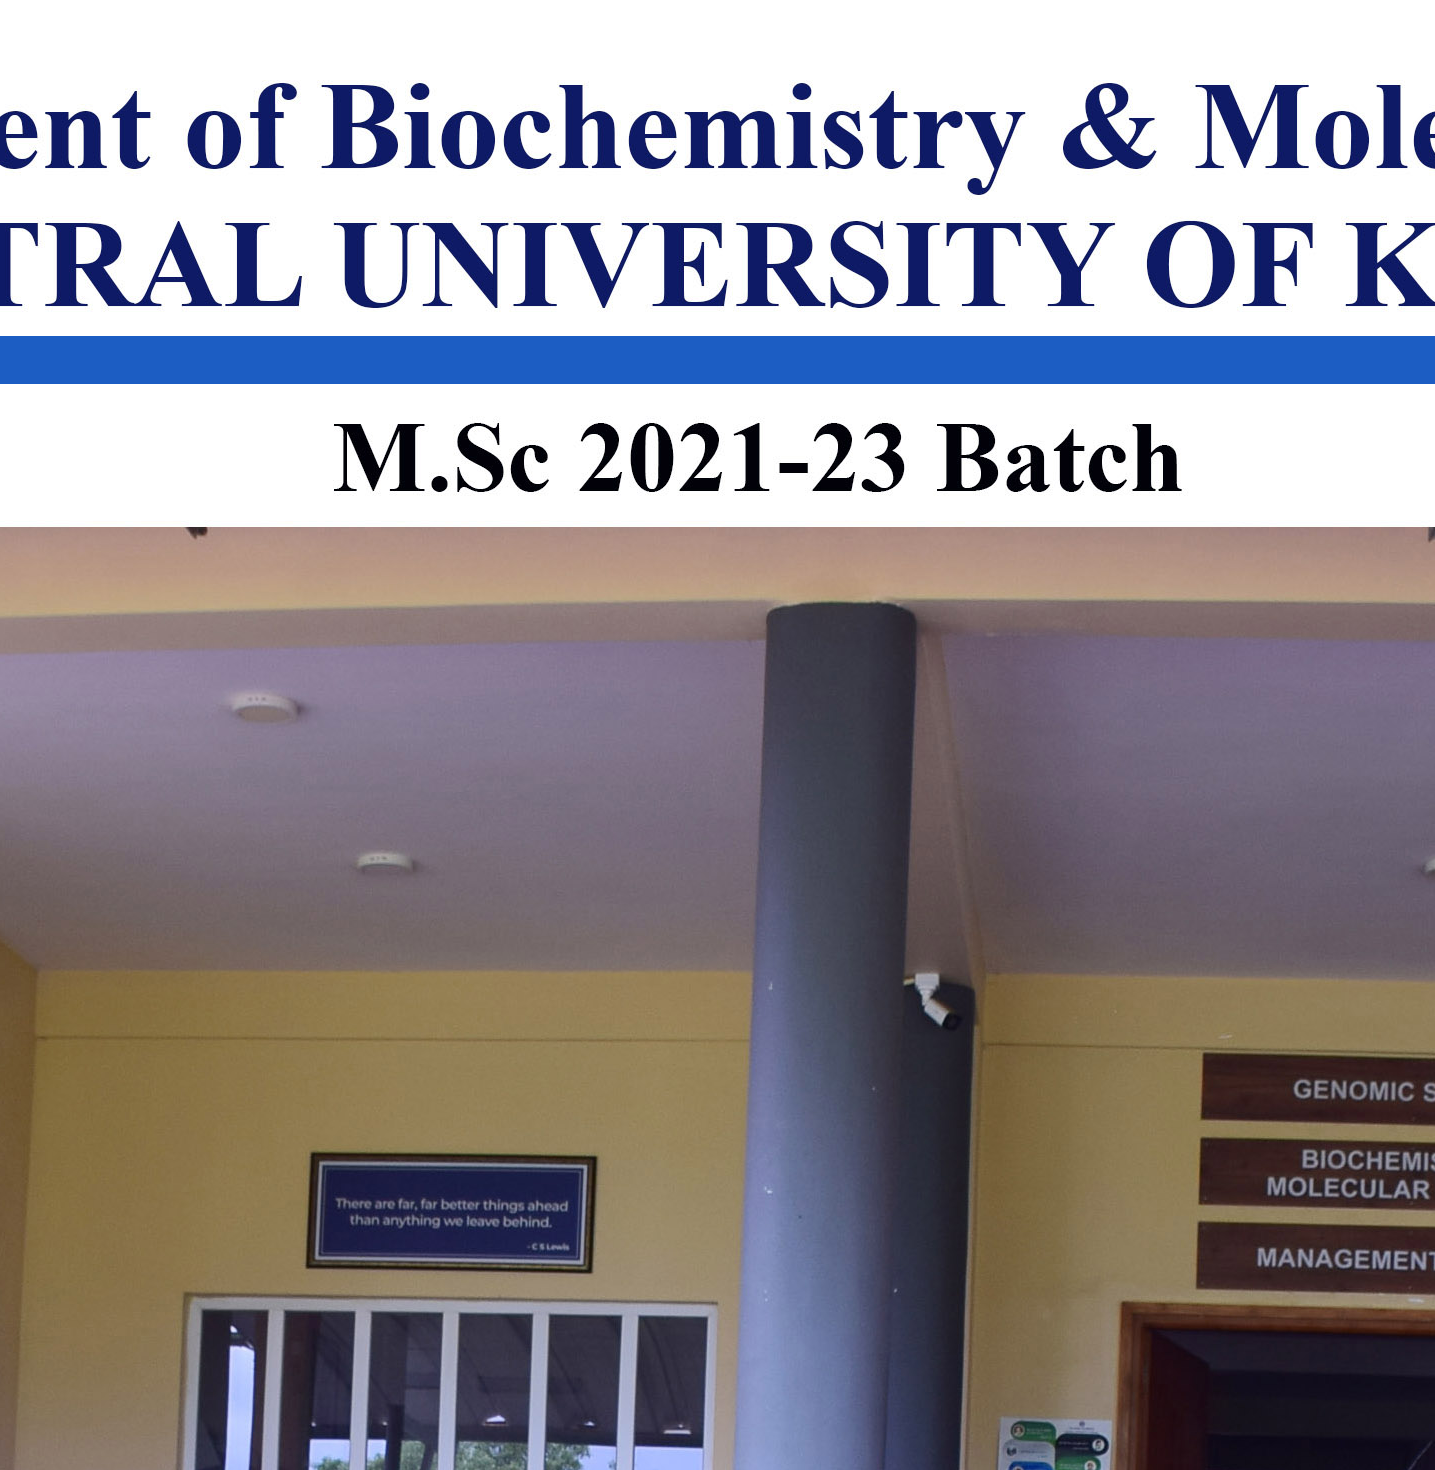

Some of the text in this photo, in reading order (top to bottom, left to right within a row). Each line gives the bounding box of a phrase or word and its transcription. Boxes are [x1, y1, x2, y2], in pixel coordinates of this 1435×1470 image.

[1293, 1079, 1415, 1103] GENOMIC
[1267, 1176, 1430, 1201] MOLECULAR
[335, 1197, 569, 1214] There are far, far better things ahead
[350, 1214, 553, 1229] than anything we leave behind.
[546, 1243, 570, 1252] Lewis
